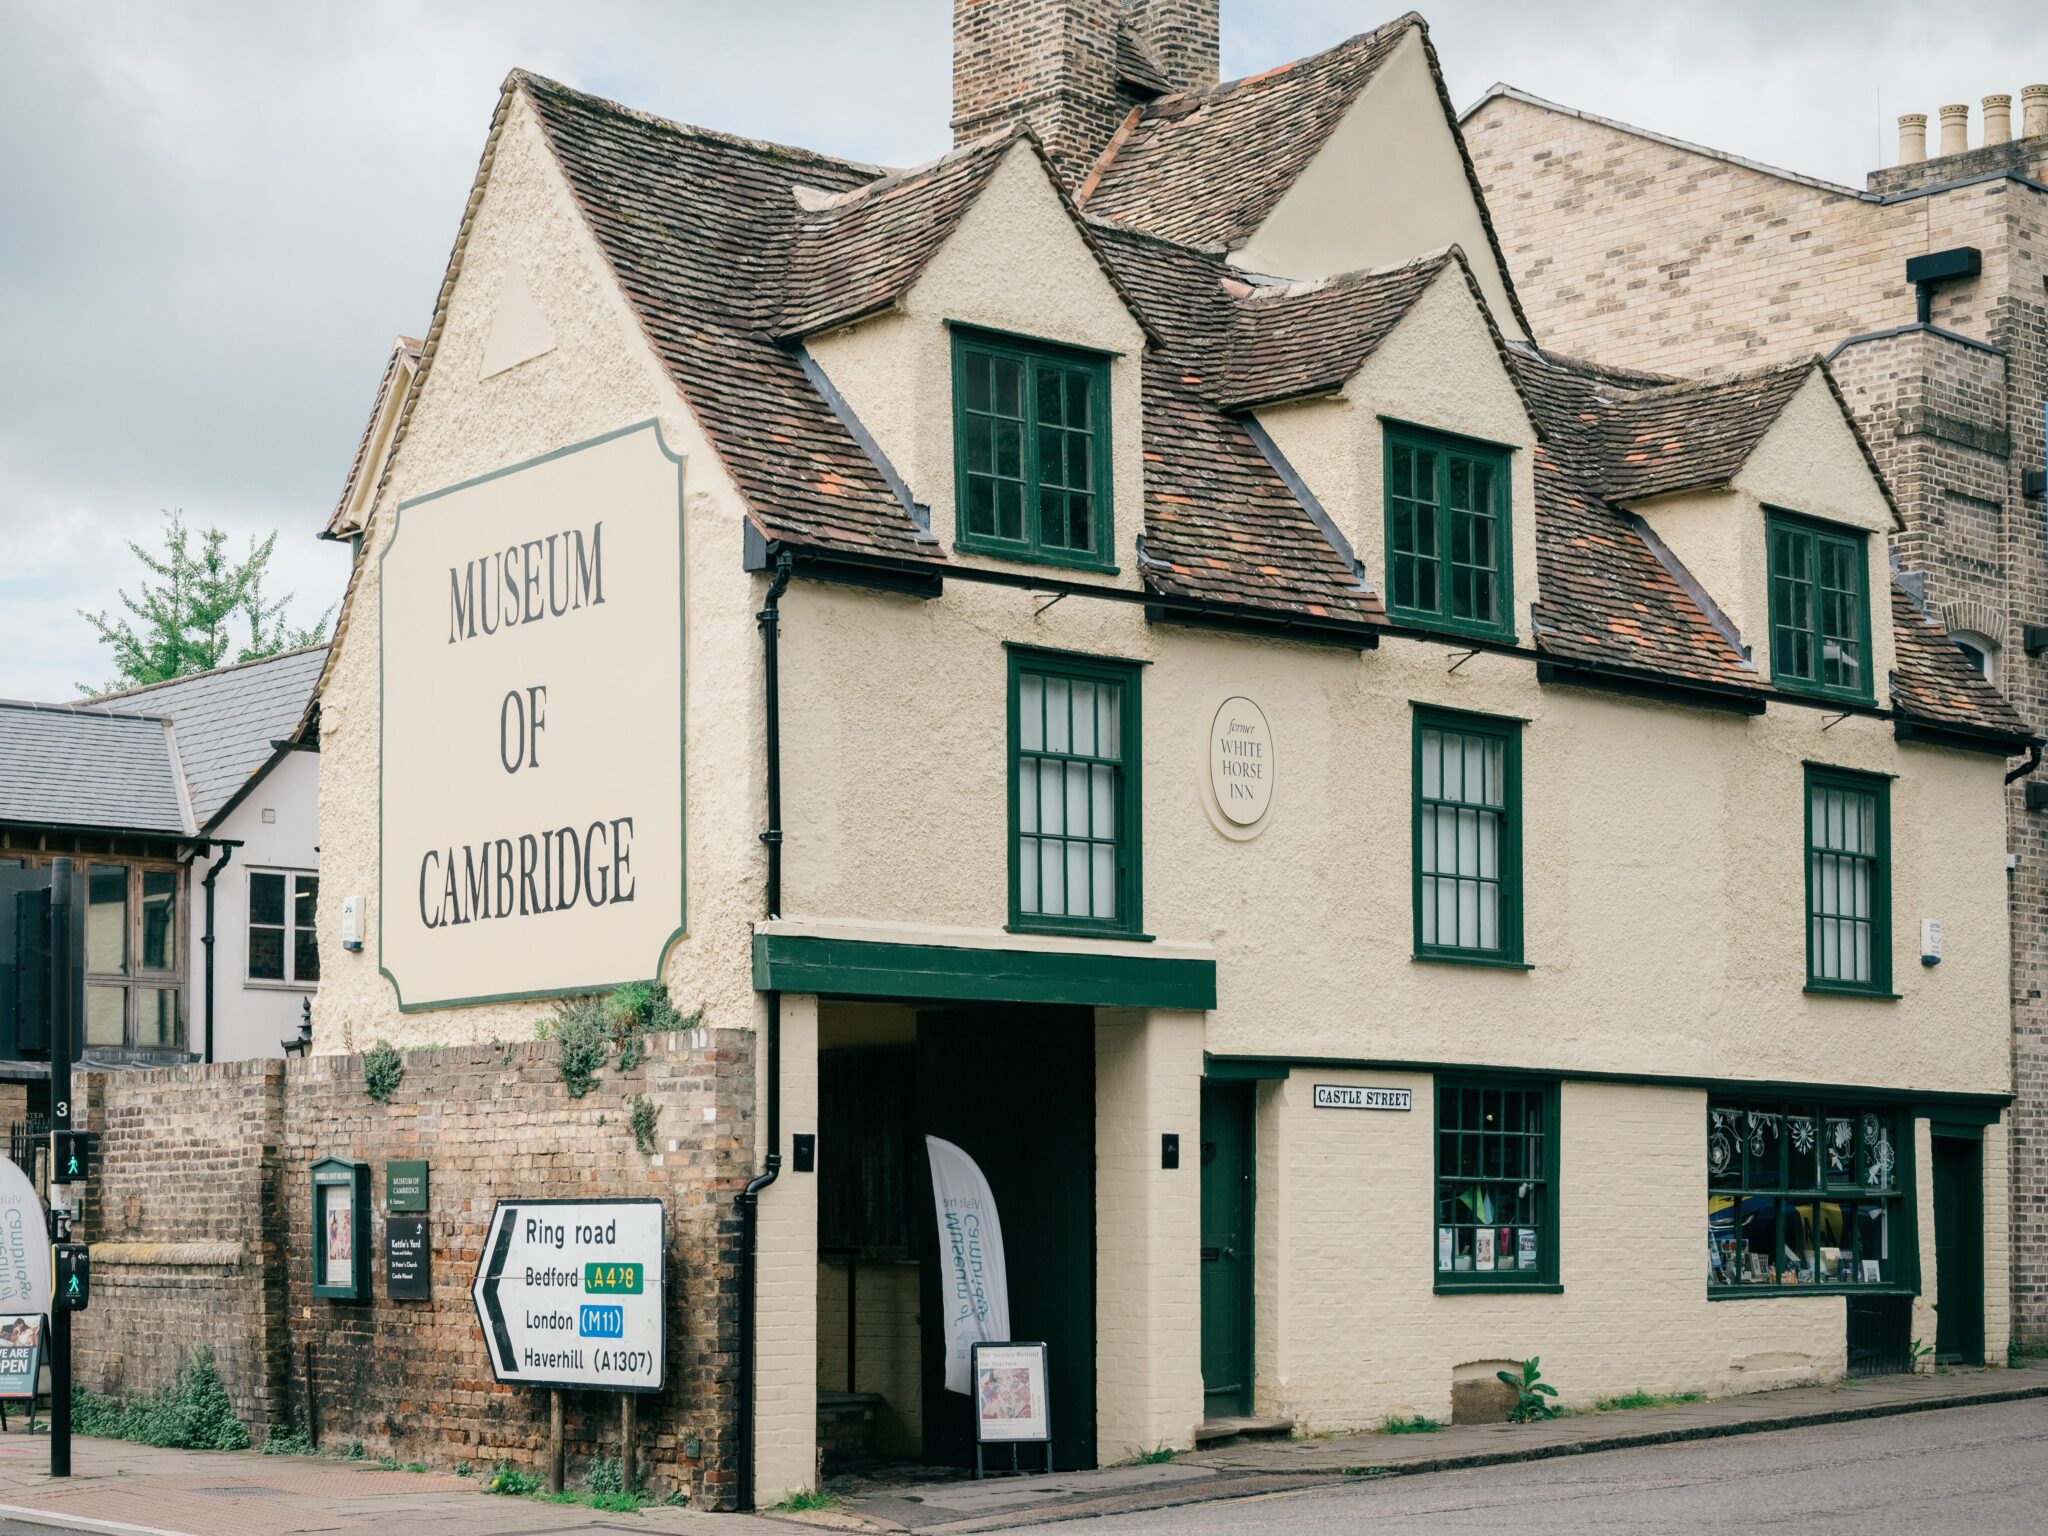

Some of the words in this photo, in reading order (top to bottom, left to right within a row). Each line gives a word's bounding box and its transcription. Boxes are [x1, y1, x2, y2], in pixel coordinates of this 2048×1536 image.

[448, 520, 606, 644] MUSEUM
[499, 684, 547, 774] OF
[1227, 718, 1256, 735] former
[1220, 738, 1263, 759] WHITE
[1222, 759, 1263, 780] HORSE
[1230, 783, 1255, 800] INN
[418, 816, 636, 930] CAMBRIDGE
[1318, 1089, 1362, 1105] CASTLE
[1366, 1091, 1409, 1107] STREET
[56, 1101, 68, 1117] 3
[393, 1177, 412, 1185] MUSEUM
[412, 1177, 420, 1185] OF
[393, 1186, 420, 1195] CAMBRIDGE
[526, 1218, 565, 1249] Ring
[575, 1218, 616, 1245] road
[409, 1239, 421, 1249] Yard
[525, 1266, 579, 1287] Bedford
[526, 1309, 573, 1330] London
[581, 1308, 621, 1334] (M11)
[9, 1348, 29, 1359] ARE
[524, 1347, 584, 1369] Haverhill
[594, 1348, 653, 1376] (A1307)
[0, 1359, 29, 1374] PEN
